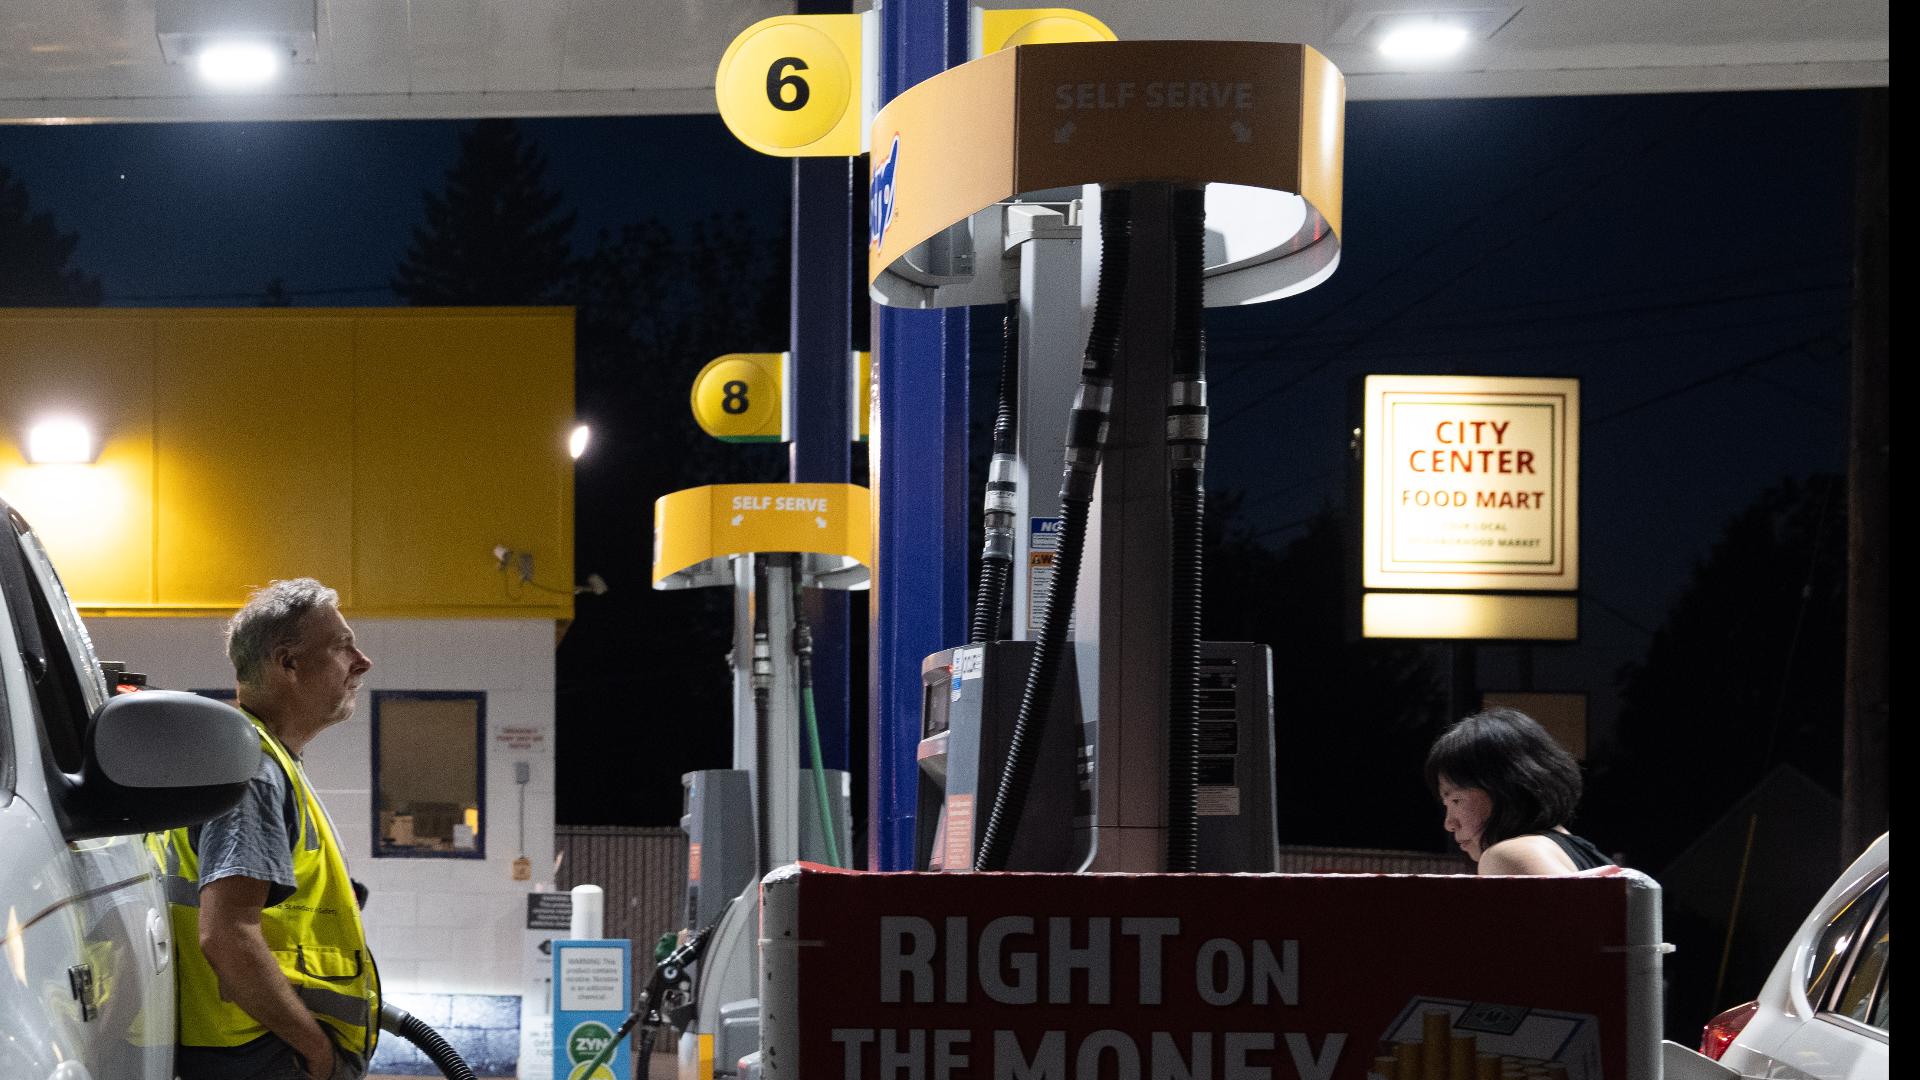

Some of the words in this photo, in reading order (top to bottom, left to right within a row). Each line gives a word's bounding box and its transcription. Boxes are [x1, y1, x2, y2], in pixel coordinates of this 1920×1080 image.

[766, 56, 810, 111] 6
[1055, 83, 1136, 111] SELF
[1146, 82, 1254, 110] SERVE
[722, 380, 750, 415] 8
[1436, 421, 1511, 444] CITY
[1409, 450, 1536, 475] CENTER
[732, 496, 772, 511] SELF
[775, 497, 828, 513] SERVE
[1402, 490, 1468, 507] FOOD
[1476, 491, 1545, 510] MART
[880, 915, 1181, 1005] RIGHT
[1195, 937, 1300, 1007] ON
[576, 1037, 610, 1051] ZYN
[832, 1027, 972, 1080] THE
[993, 1029, 1349, 1080] MONEY
